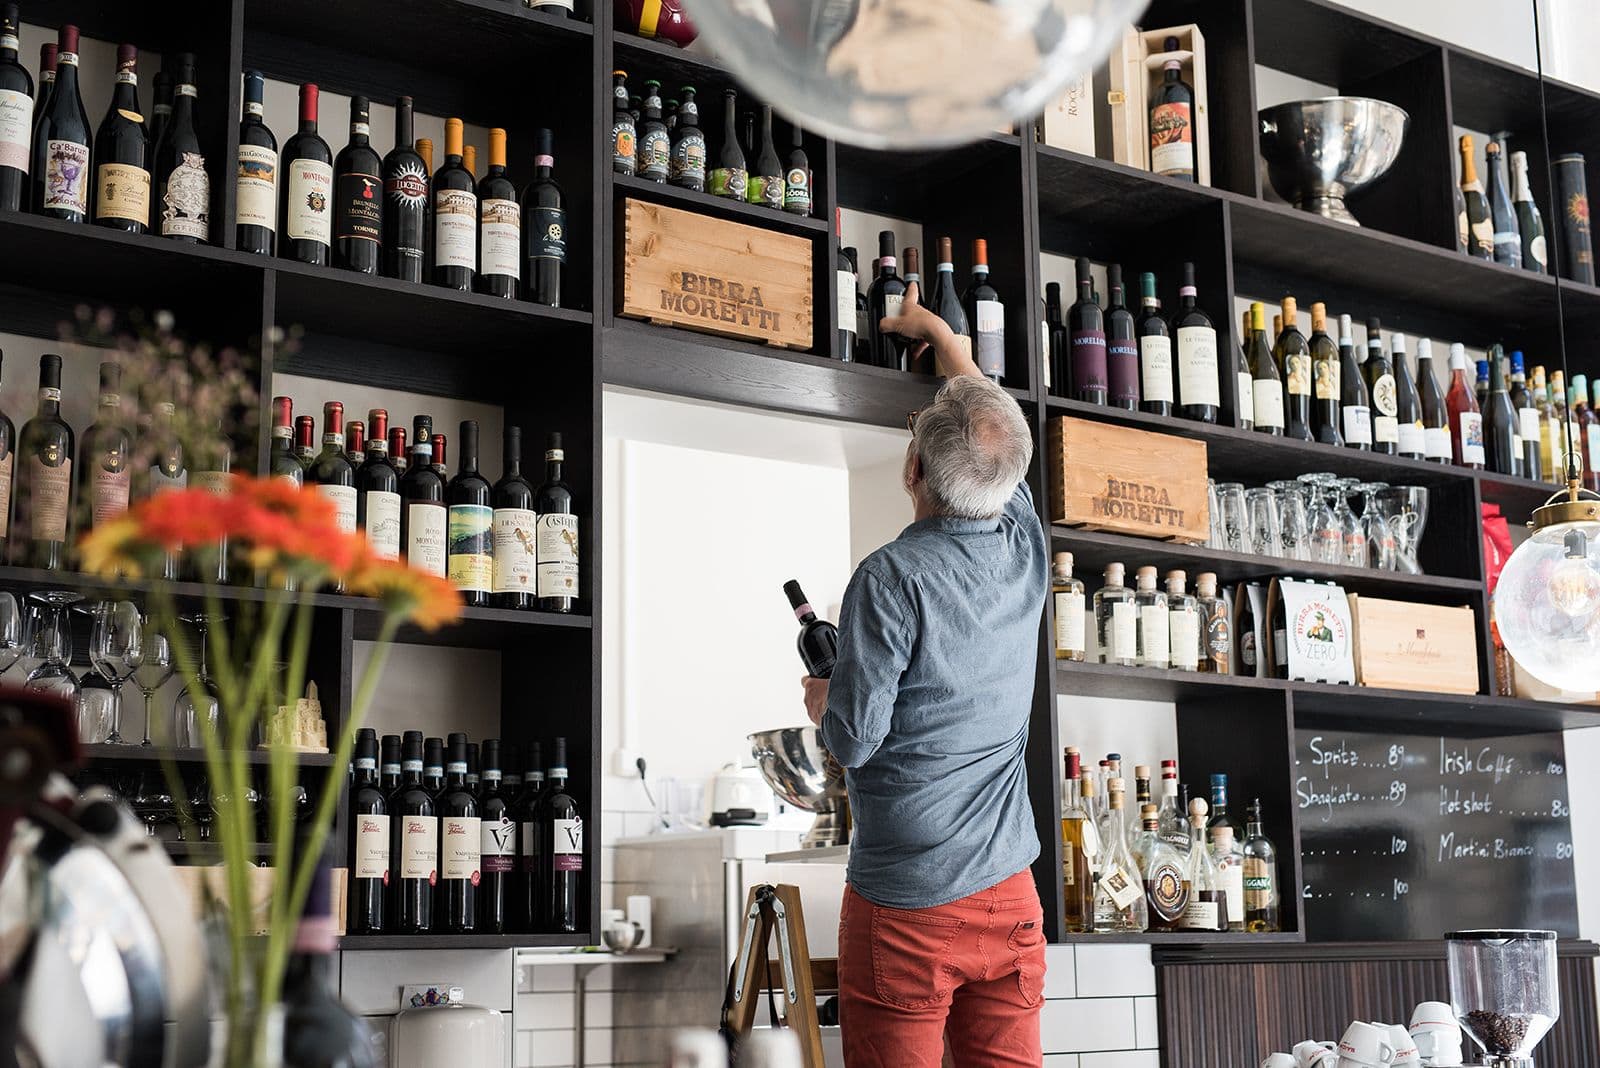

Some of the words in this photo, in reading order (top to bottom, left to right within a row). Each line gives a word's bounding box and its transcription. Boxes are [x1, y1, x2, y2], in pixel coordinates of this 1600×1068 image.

[681, 271, 764, 308] BIRRA
[660, 289, 780, 332] MORETTI
[1107, 478, 1172, 507] BIRRA
[1092, 496, 1185, 528] MORETTI
[1306, 642, 1337, 662] ZERO
[1440, 736, 1473, 775] Irish
[1551, 799, 1569, 818] 80
[1391, 835, 1407, 855] 100
[1393, 877, 1409, 901] 100
